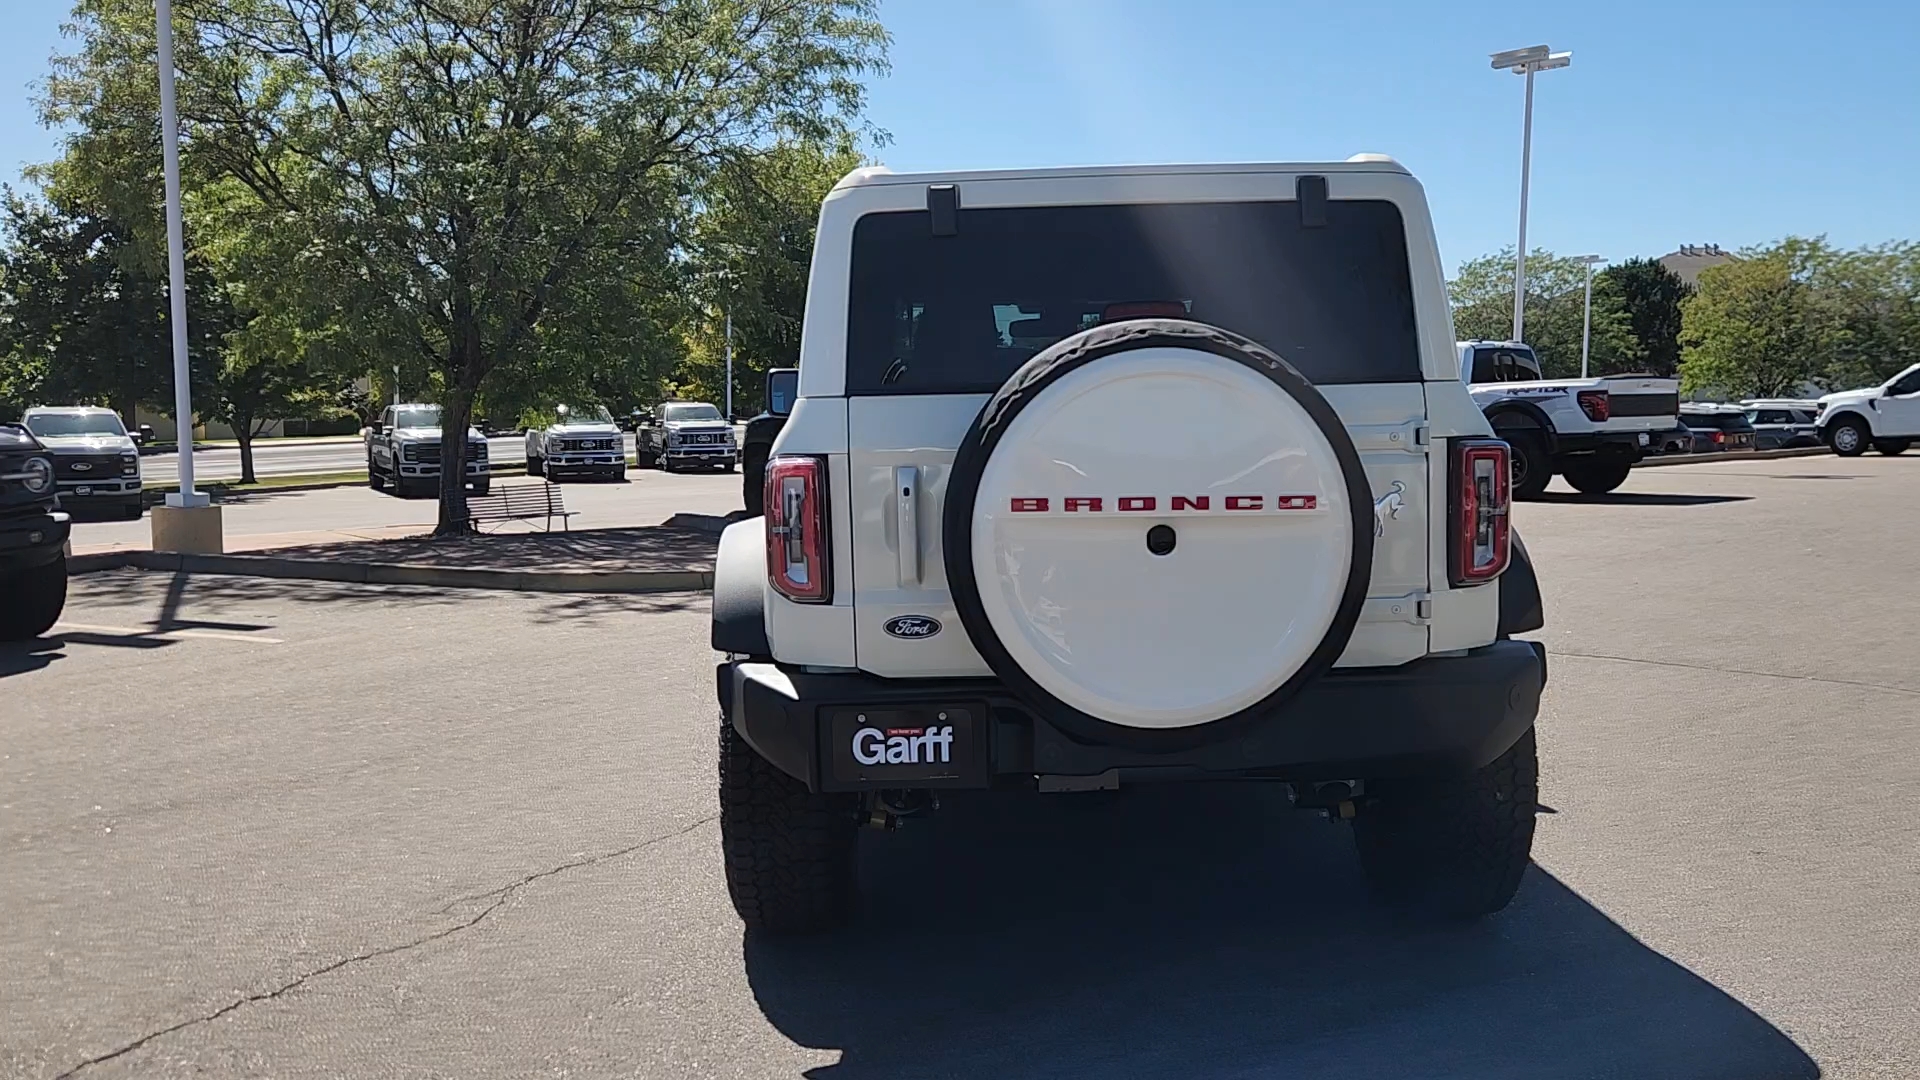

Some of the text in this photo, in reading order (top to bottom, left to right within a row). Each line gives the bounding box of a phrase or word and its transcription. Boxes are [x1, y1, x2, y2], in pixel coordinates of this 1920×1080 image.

[1507, 387, 1569, 395] RAPTOR
[1011, 496, 1316, 512] BRONCO
[895, 619, 931, 634] Ford
[852, 726, 953, 765] Garff
